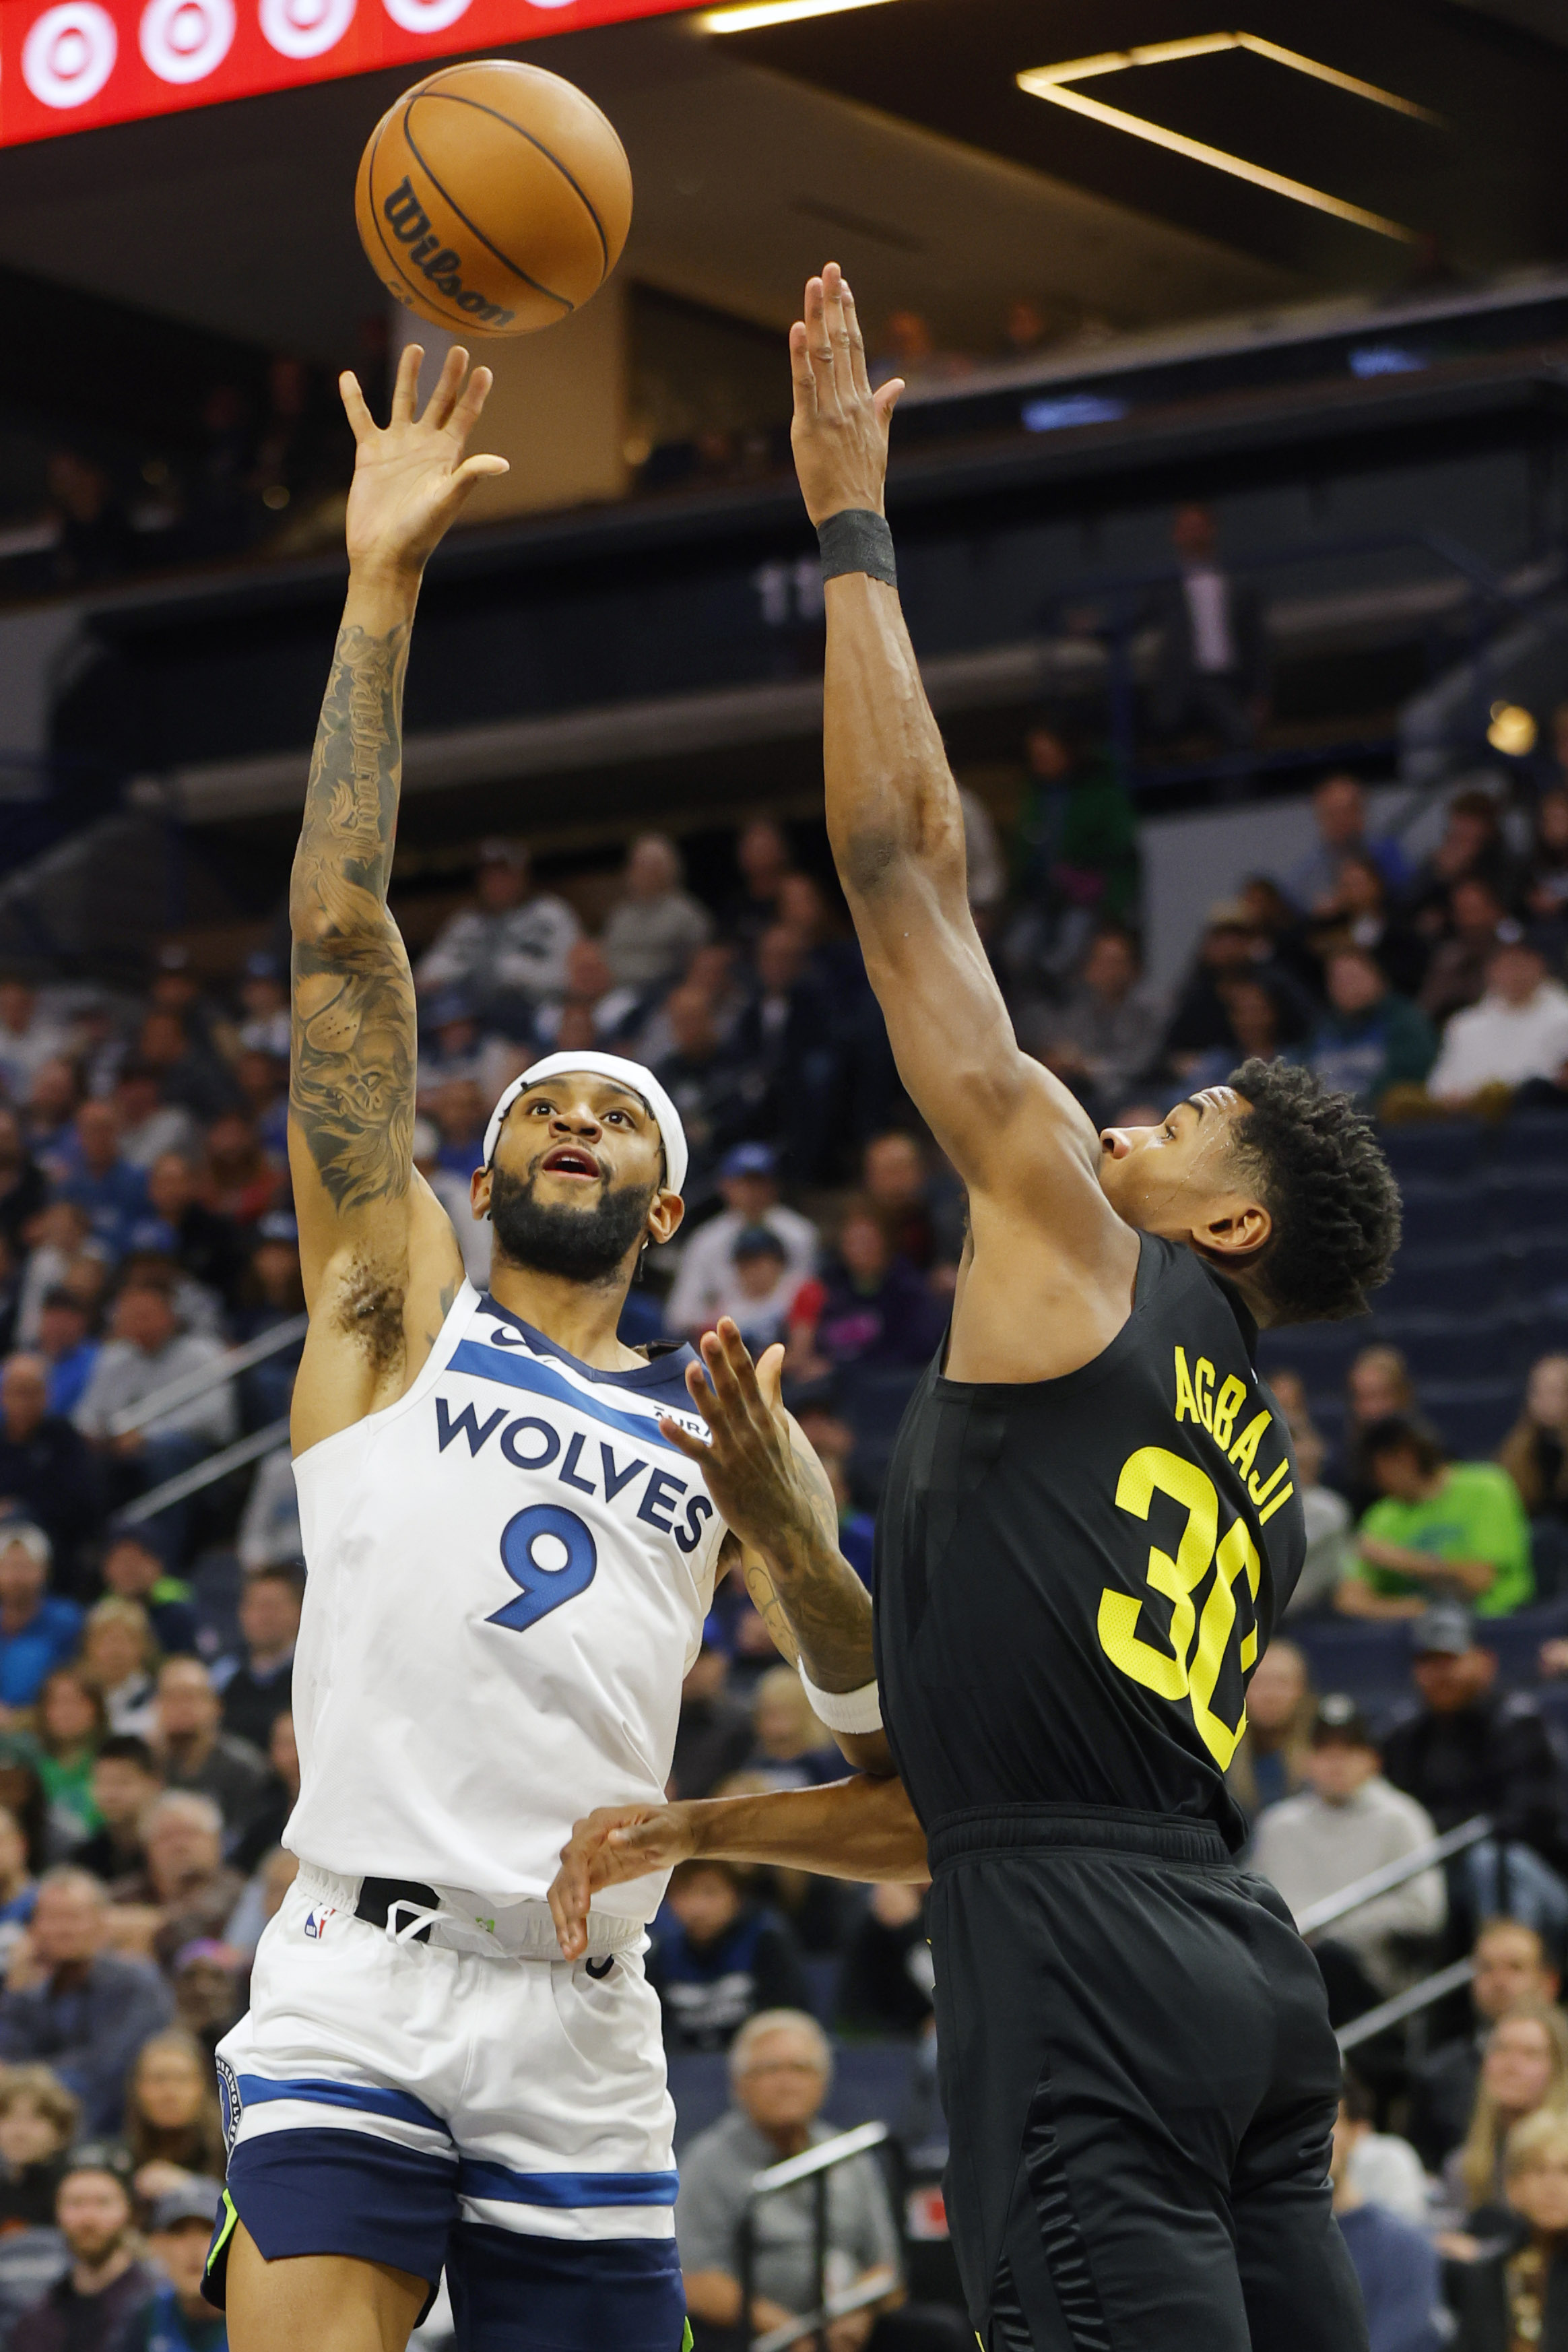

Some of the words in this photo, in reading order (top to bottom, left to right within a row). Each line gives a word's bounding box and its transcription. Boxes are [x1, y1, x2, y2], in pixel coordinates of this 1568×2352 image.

[383, 174, 516, 327] Wilson
[435, 1396, 713, 1553] WOLVES
[1174, 1346, 1293, 1526] AGBAJI
[484, 1503, 597, 1633] 9
[1097, 1446, 1262, 1773] 30
